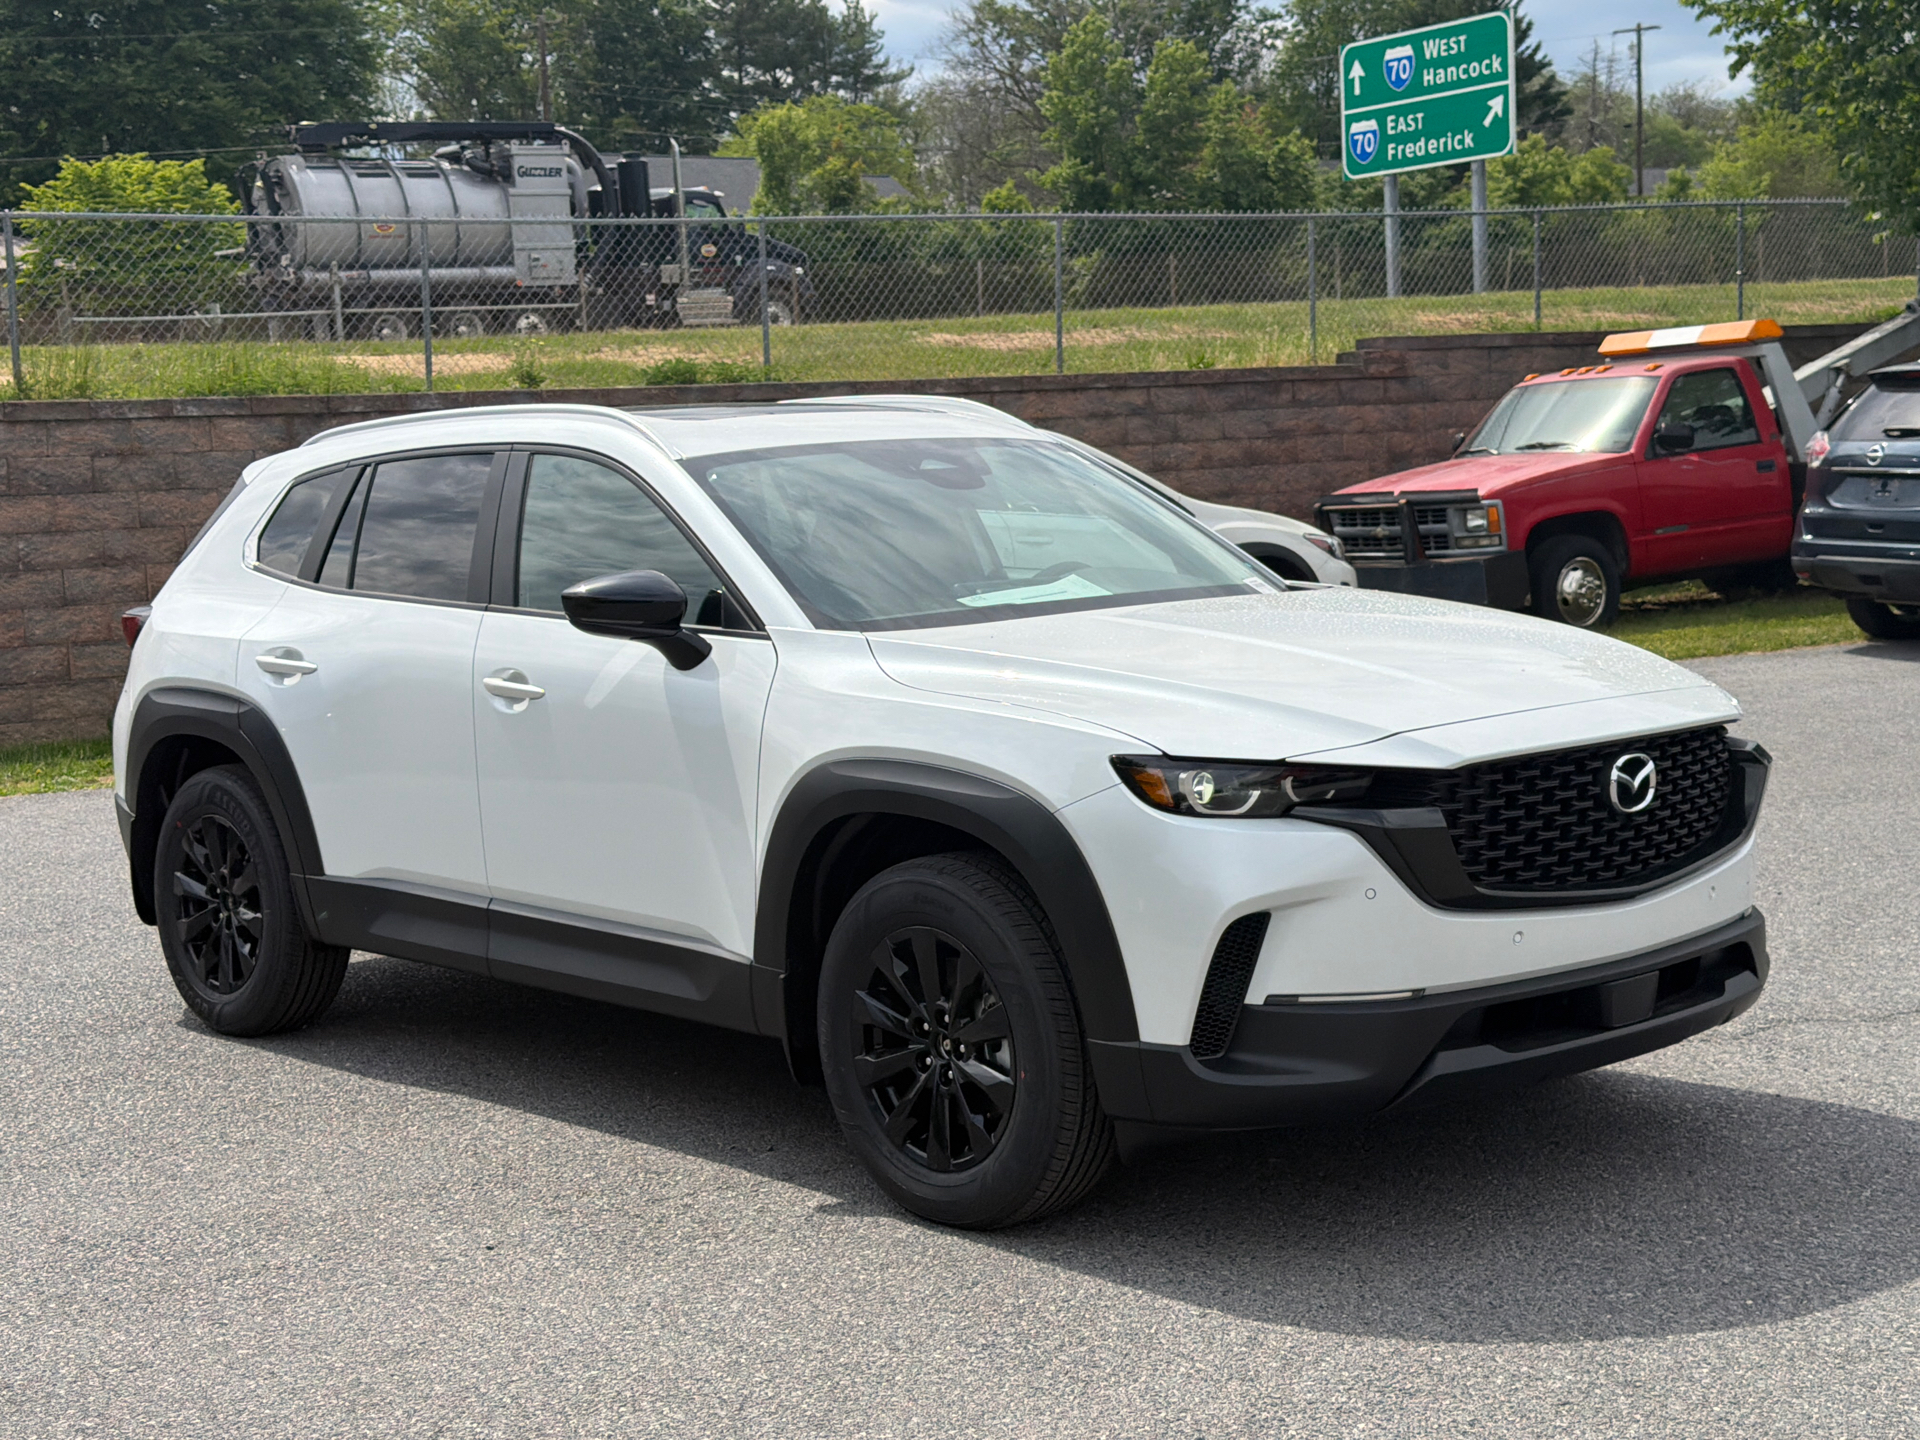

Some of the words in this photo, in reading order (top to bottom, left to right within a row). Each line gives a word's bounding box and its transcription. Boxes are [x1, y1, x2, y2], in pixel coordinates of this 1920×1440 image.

[1422, 34, 1467, 60] WEST
[1387, 58, 1410, 82] 70
[1422, 53, 1503, 87] Hancock
[1386, 112, 1425, 135] EAST
[1353, 132, 1375, 155] 70
[1387, 129, 1475, 161] Frederick
